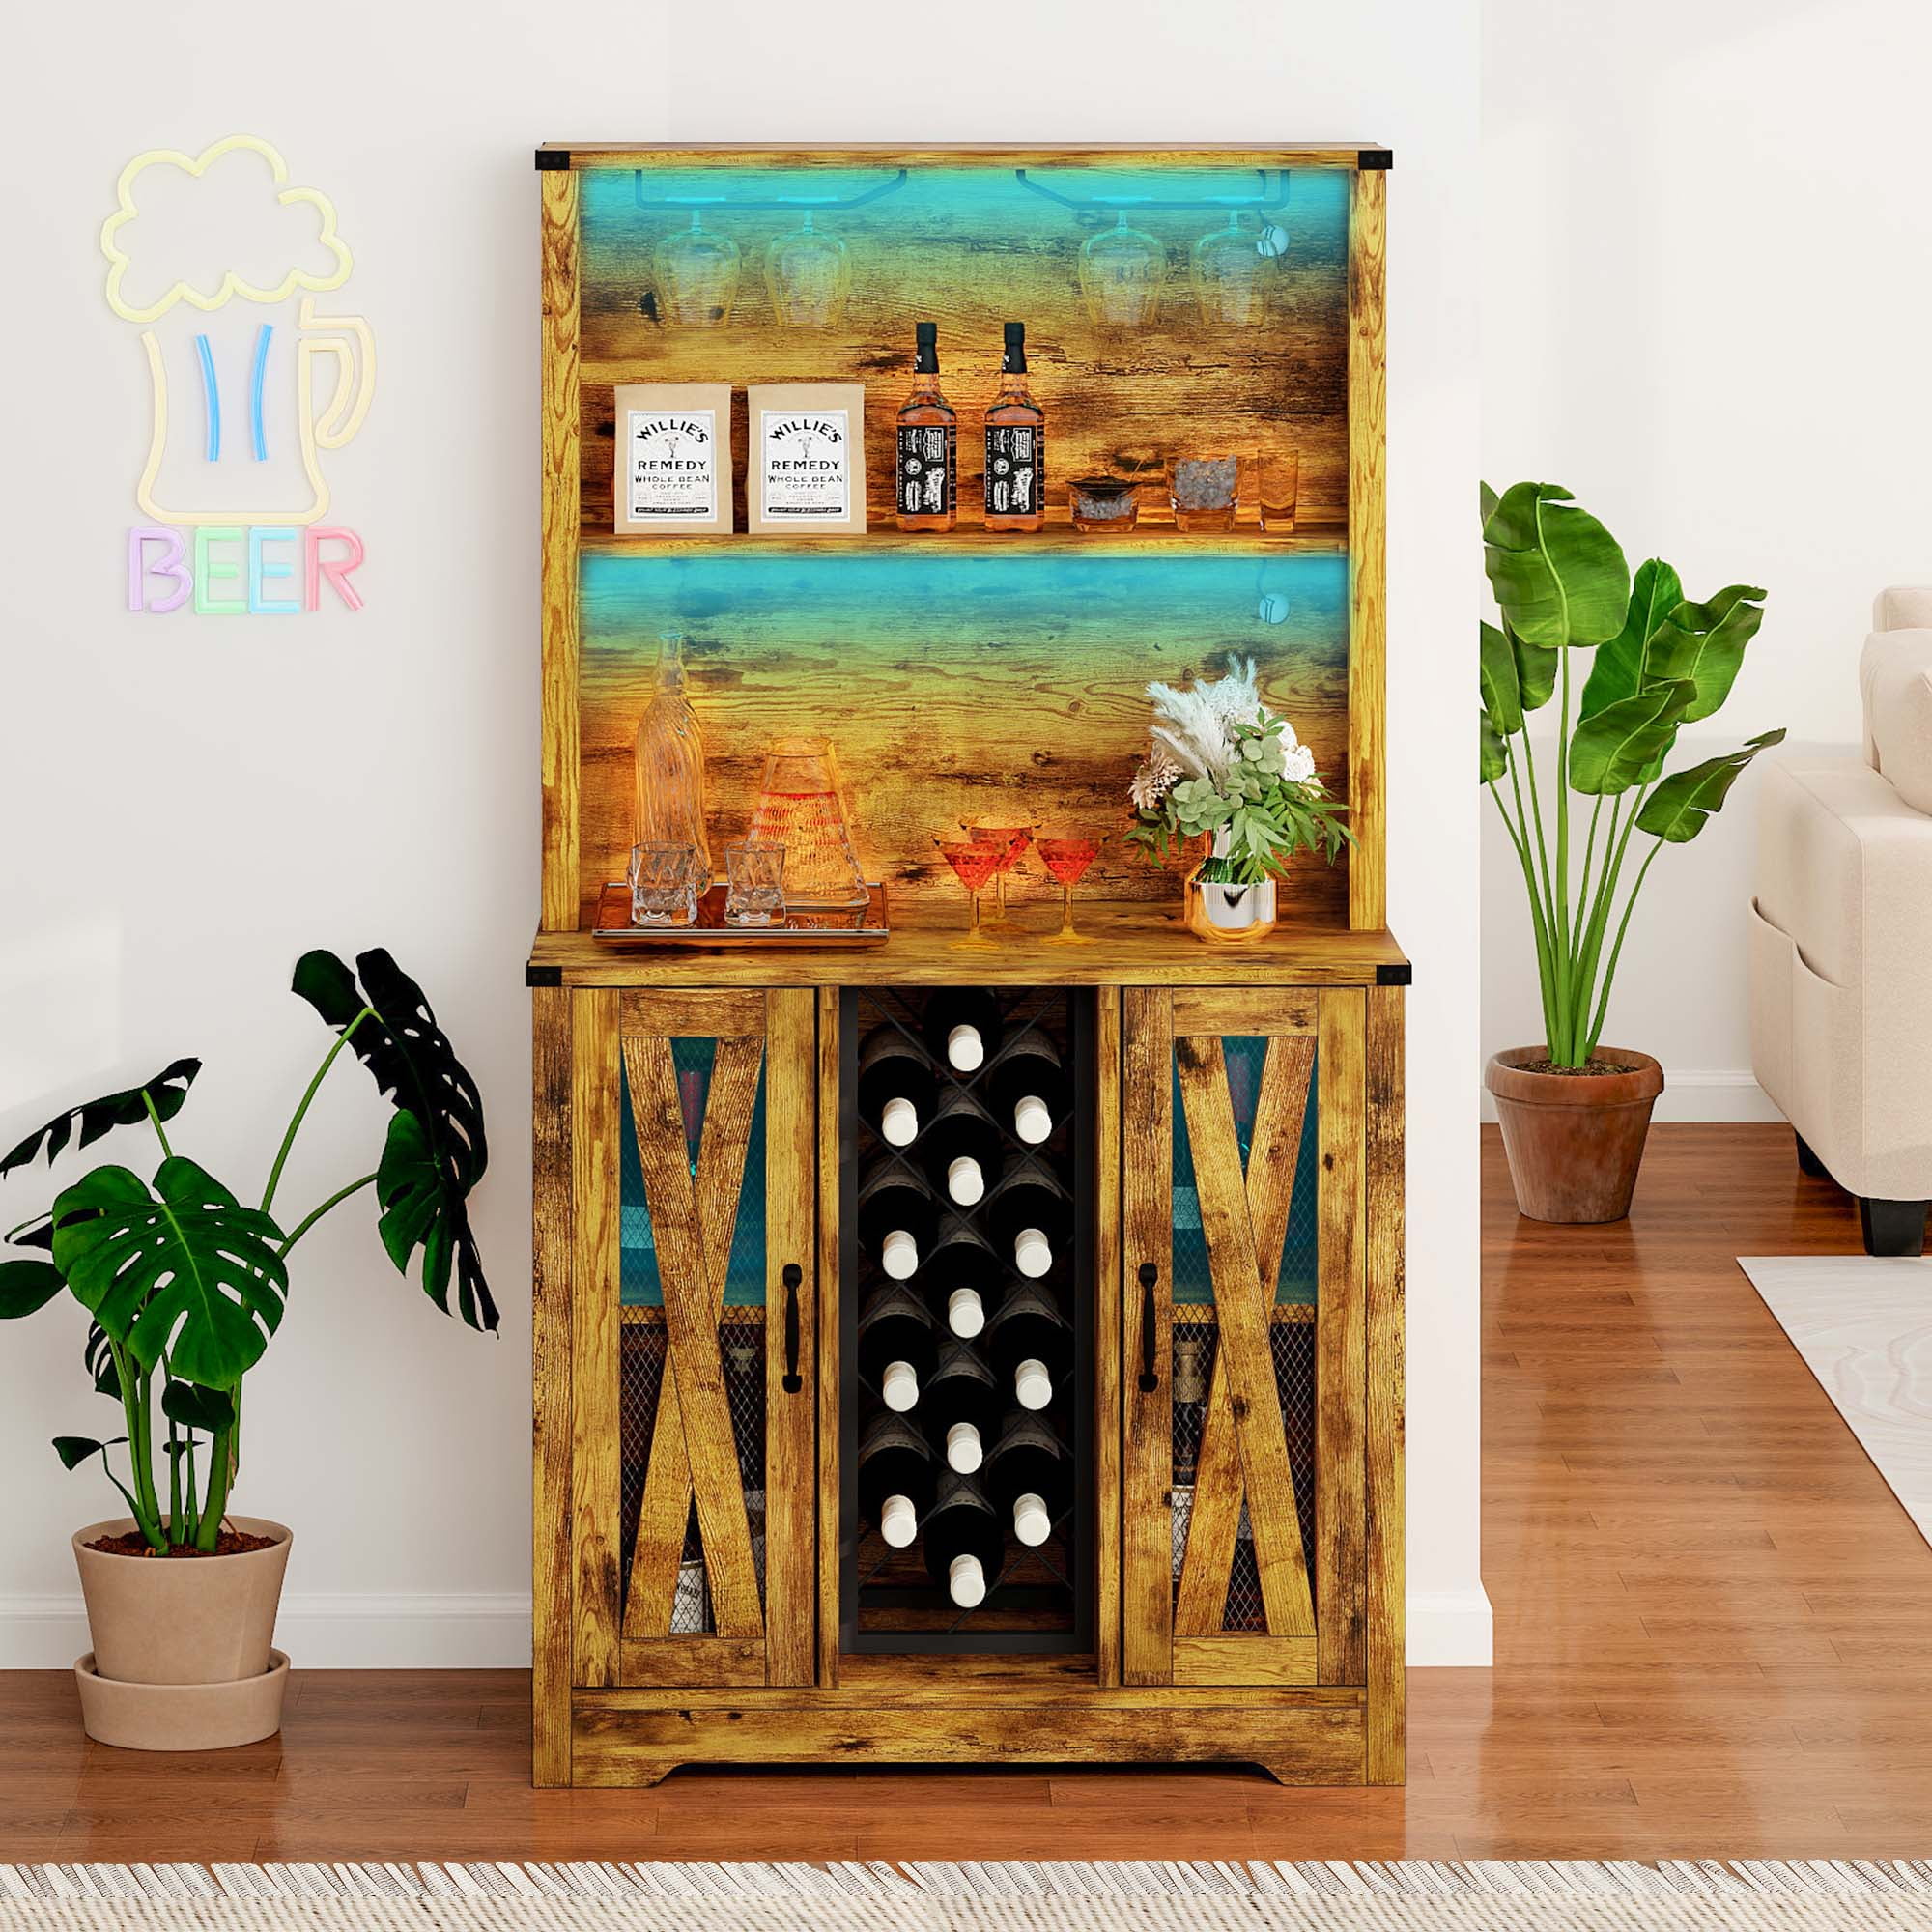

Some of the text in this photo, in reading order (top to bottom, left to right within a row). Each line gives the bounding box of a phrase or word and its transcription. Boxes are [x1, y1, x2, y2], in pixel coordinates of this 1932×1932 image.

[636, 418, 709, 443] WILLIE'S
[769, 418, 842, 443] WILLIE'S
[638, 460, 707, 470] REMEDY
[771, 460, 840, 470] REMEDY
[678, 474, 710, 483] BEAN
[811, 474, 843, 483] BEAN
[128, 525, 365, 615] BEER
